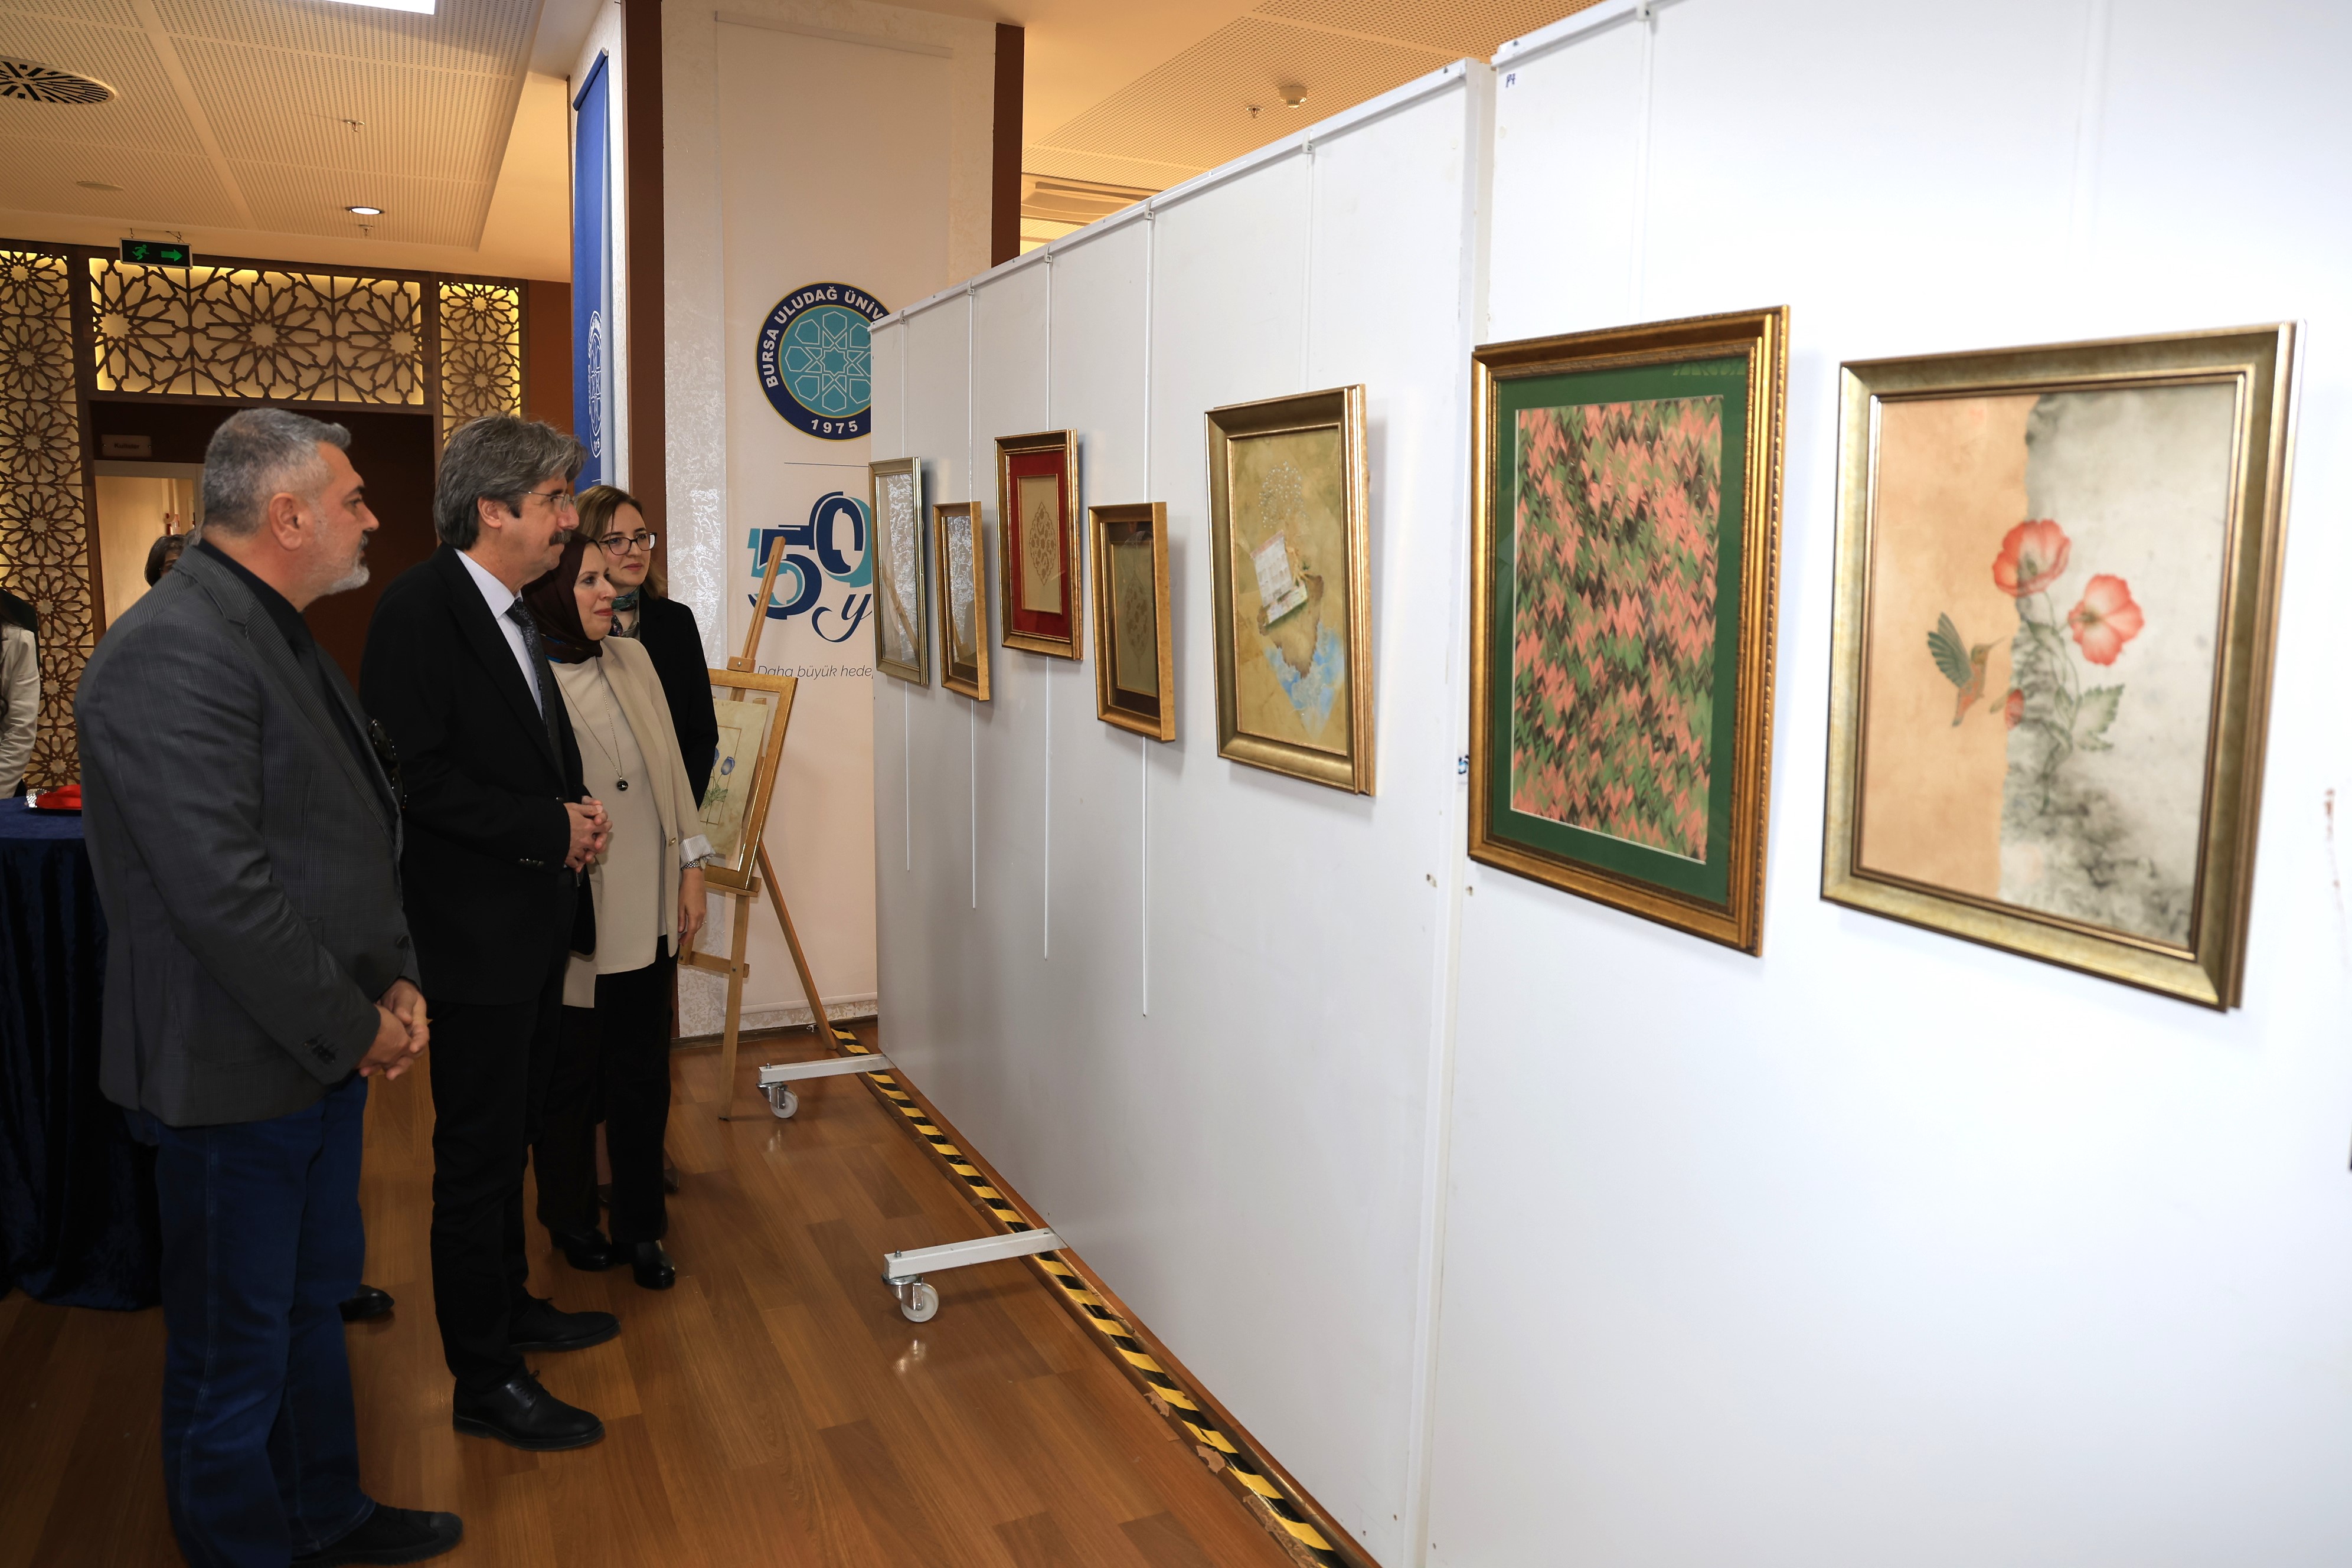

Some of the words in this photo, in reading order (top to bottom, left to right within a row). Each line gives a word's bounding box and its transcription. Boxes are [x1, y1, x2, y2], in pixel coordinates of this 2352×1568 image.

[762, 329, 780, 388] BURSA
[773, 286, 838, 324] ULUDAĞ
[844, 289, 884, 320] ÜNİV
[811, 419, 858, 434] 1975
[747, 491, 872, 620] 50
[811, 593, 873, 643] y
[757, 665, 793, 677] Daha
[797, 665, 838, 680] büyük
[840, 665, 873, 680] hede
